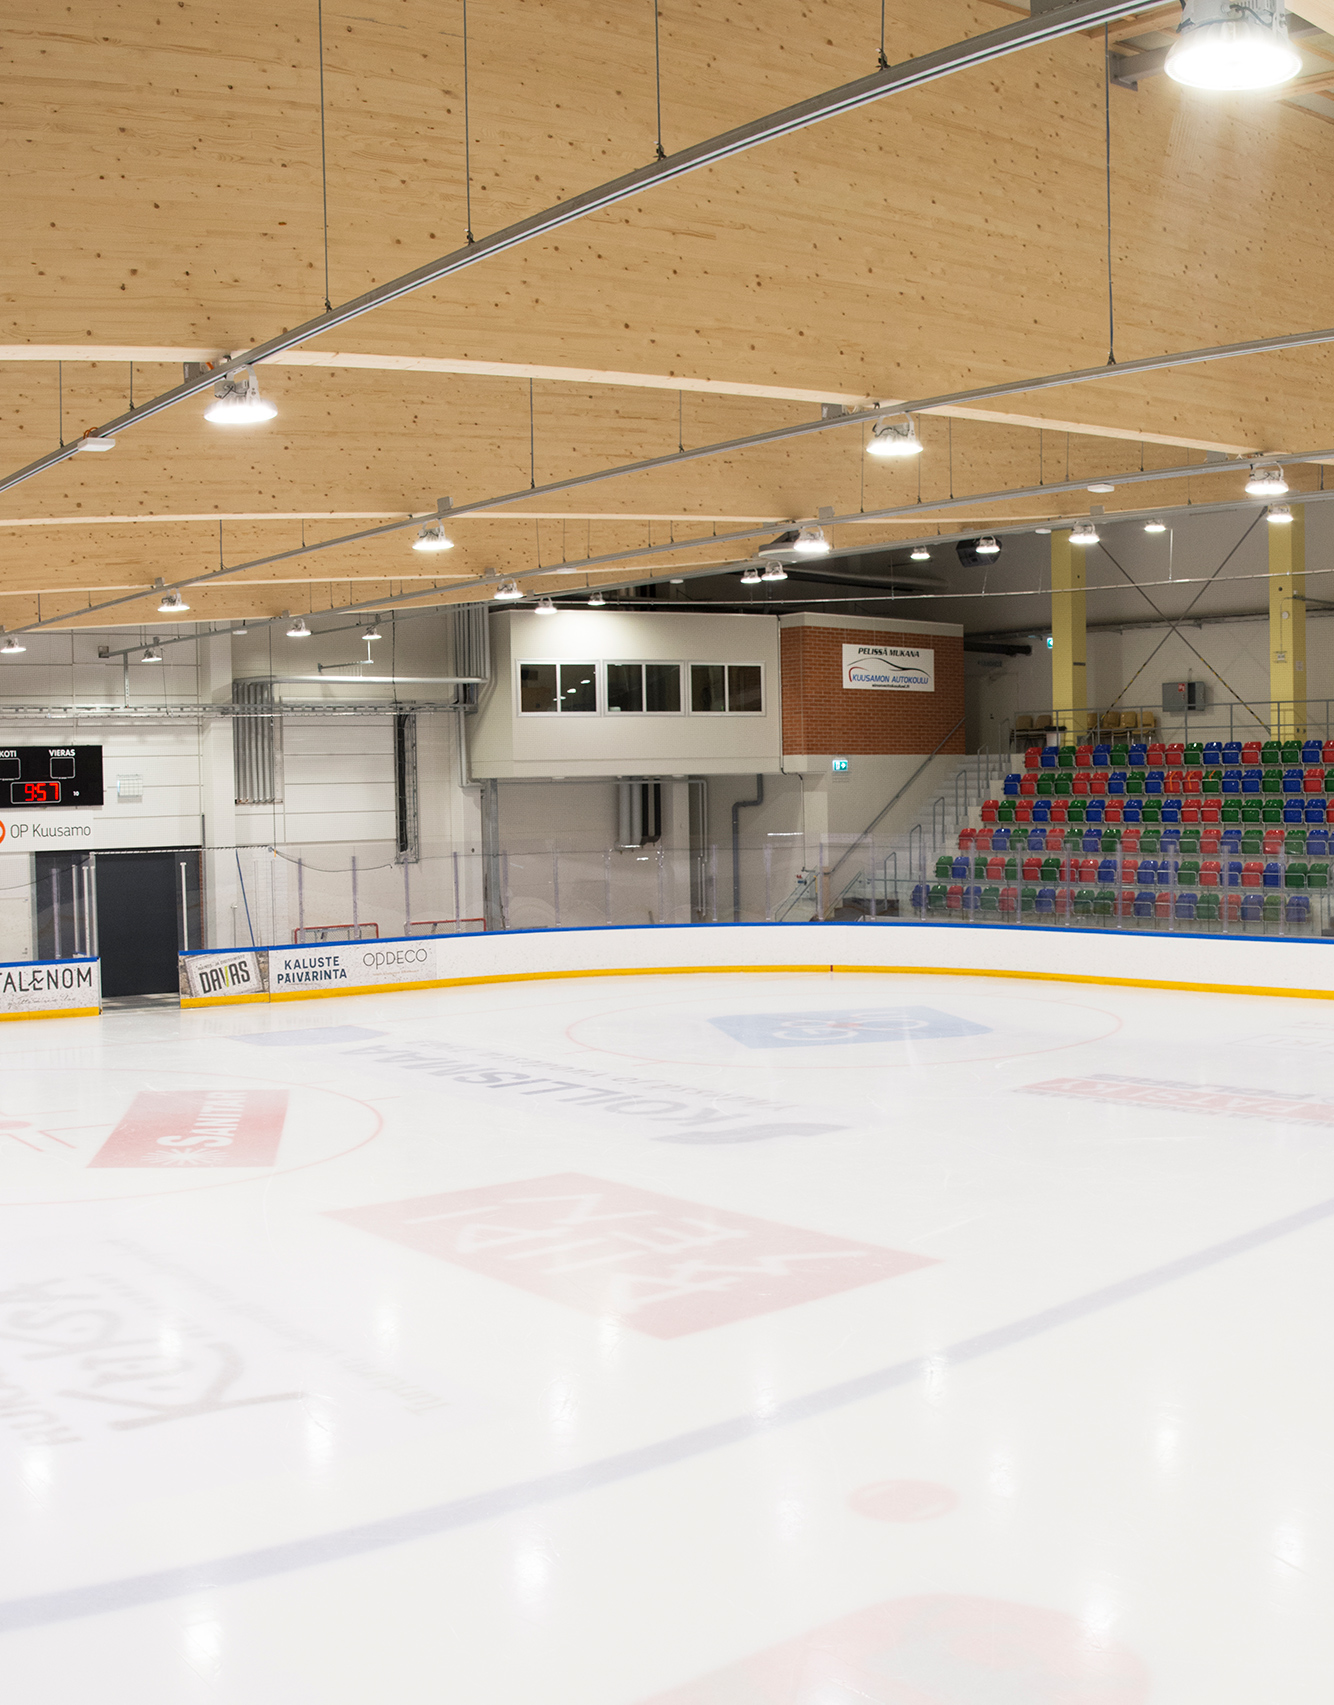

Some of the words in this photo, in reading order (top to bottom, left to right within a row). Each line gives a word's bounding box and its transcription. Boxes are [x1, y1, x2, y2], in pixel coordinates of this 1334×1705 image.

[858, 647, 888, 656] PELISSÄ
[889, 649, 920, 658] MUKANA
[852, 674, 890, 683] KUUSAMON
[892, 677, 929, 685] AUTOKOULU
[49, 749, 76, 757] VIERAS
[24, 782, 59, 802] 9:57
[10, 824, 28, 839] OP
[33, 823, 91, 838] Kuusamo
[285, 956, 340, 970] KALUSTE
[0, 967, 92, 993] ALENOM
[199, 961, 251, 994] DAVAS
[338, 1045, 752, 1126] KOILLISMAA
[157, 1091, 247, 1147] SANITAR
